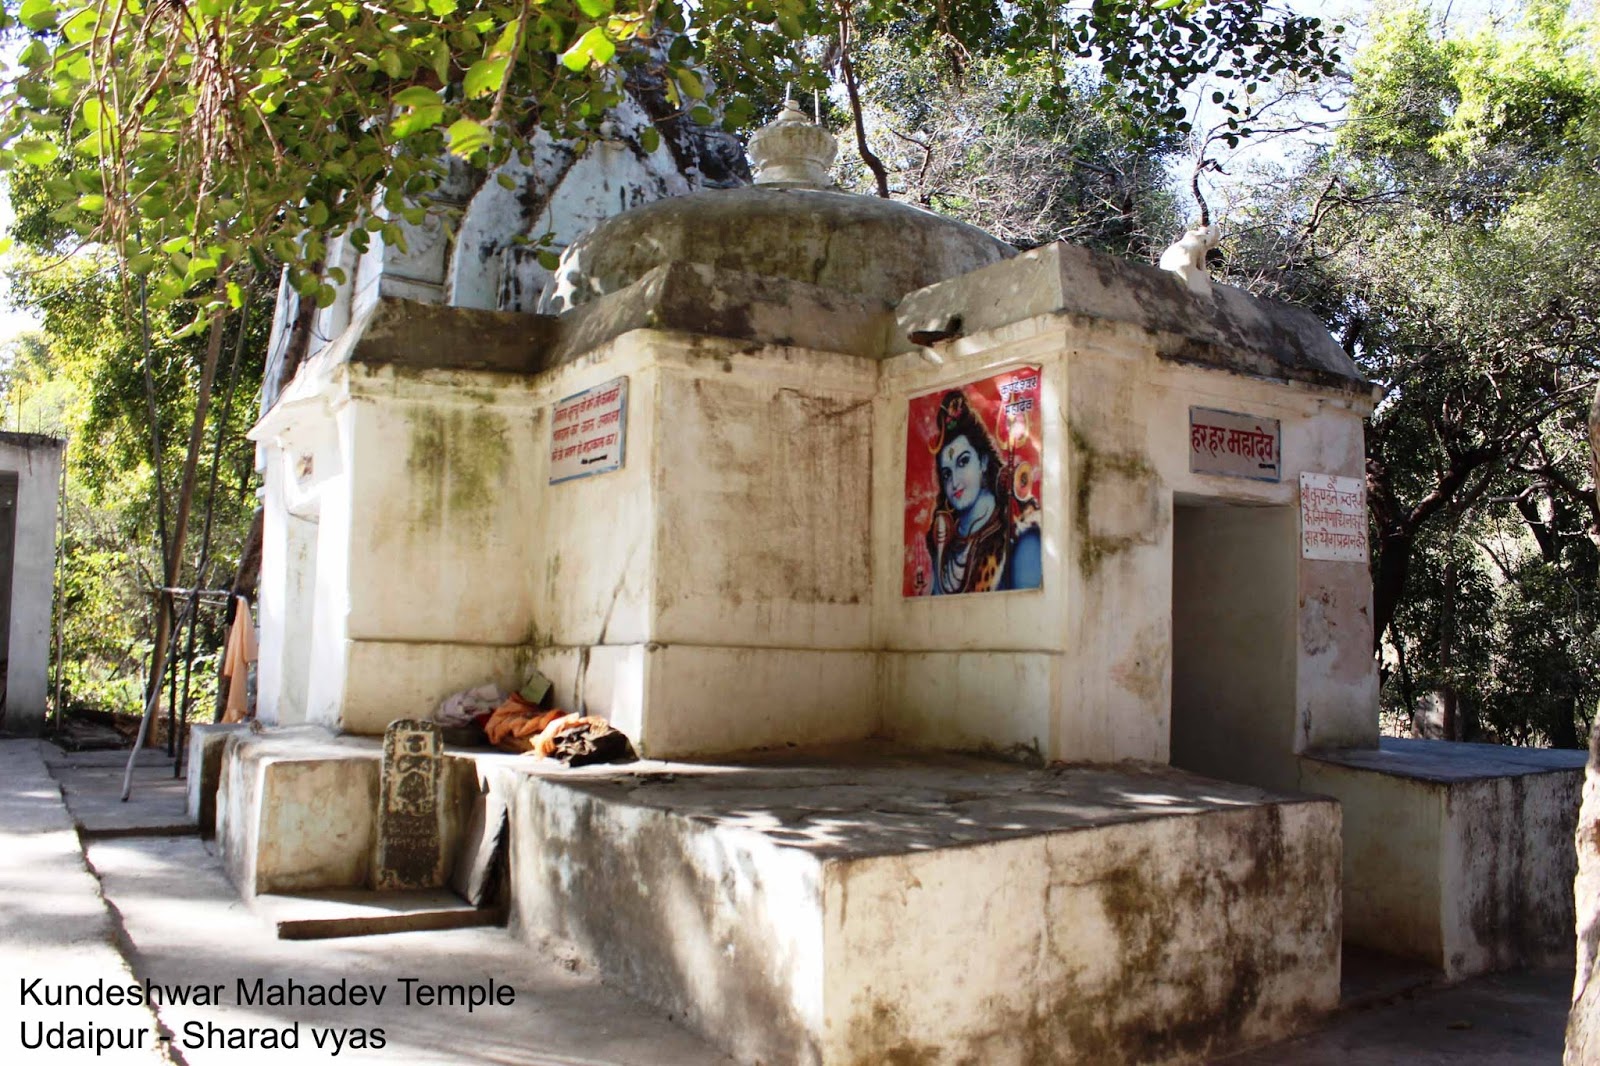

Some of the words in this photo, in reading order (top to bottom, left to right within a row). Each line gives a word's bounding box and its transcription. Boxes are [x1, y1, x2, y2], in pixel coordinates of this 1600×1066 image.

[1005, 397, 1033, 415] महादेव
[1192, 424, 1208, 453] हर
[1209, 426, 1226, 458] हर
[1227, 425, 1275, 462] महादेव
